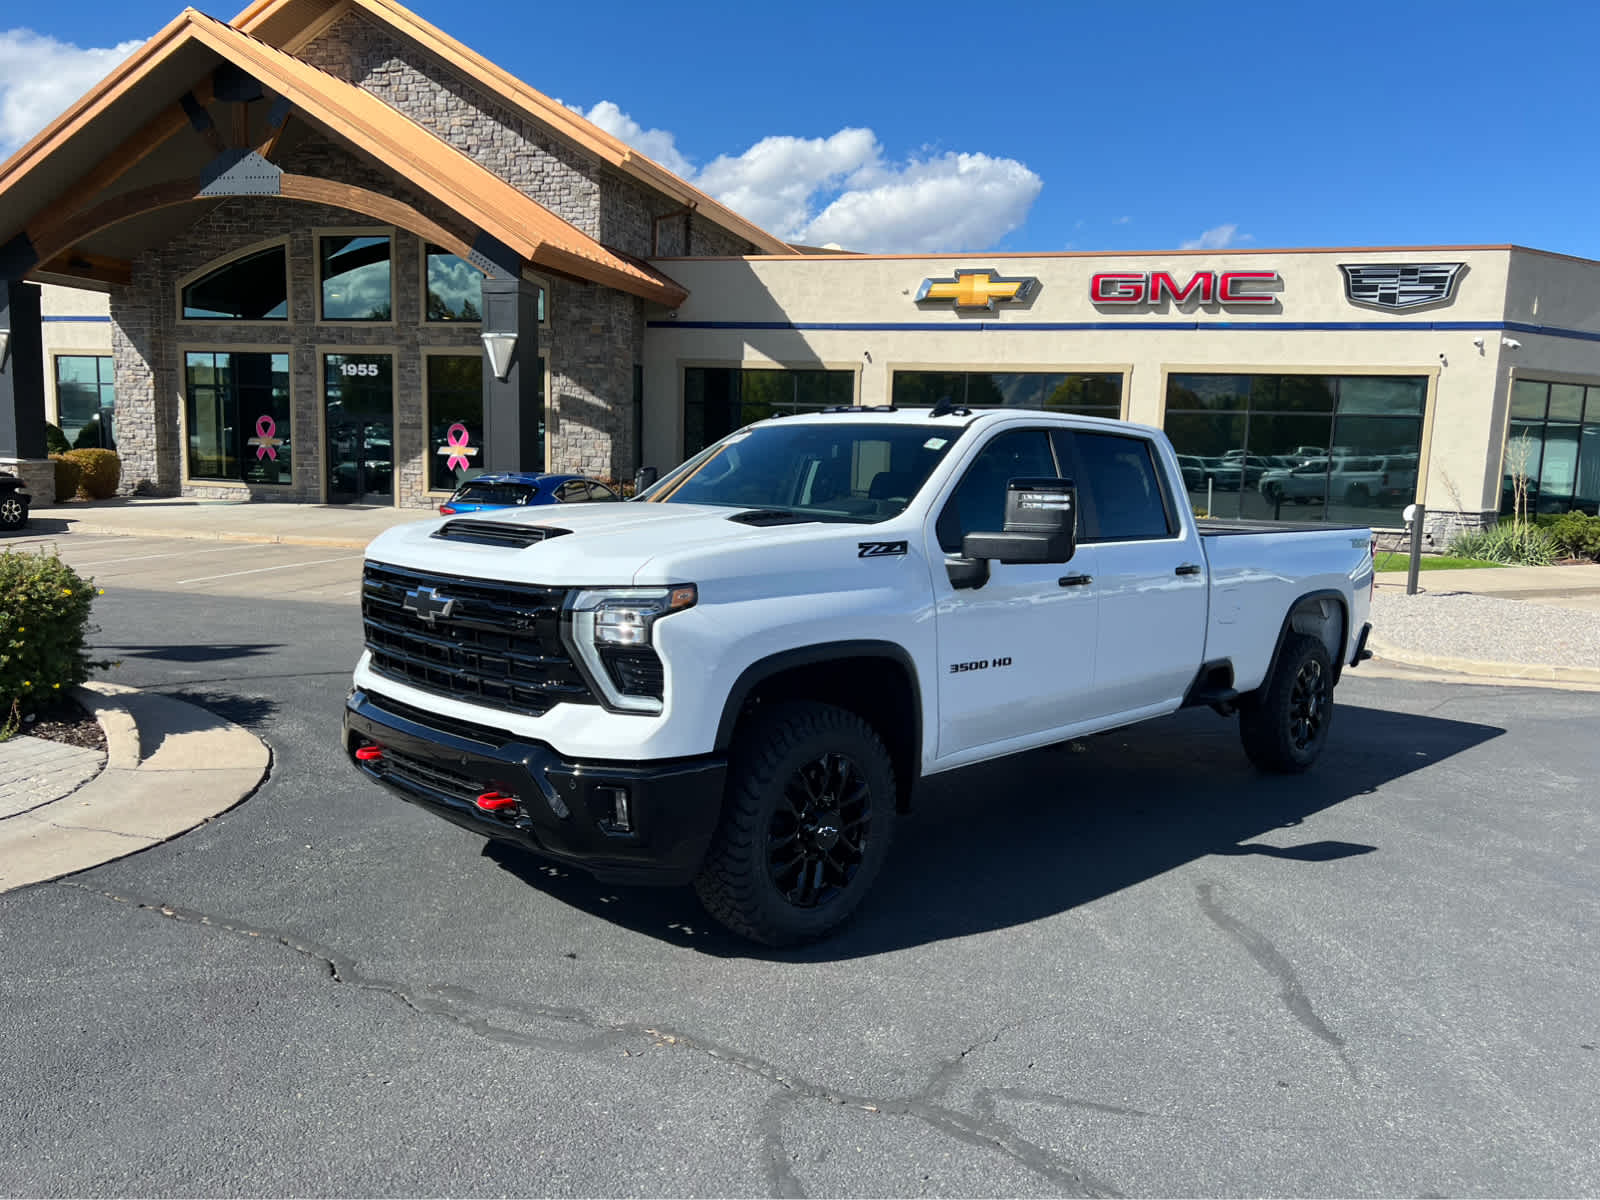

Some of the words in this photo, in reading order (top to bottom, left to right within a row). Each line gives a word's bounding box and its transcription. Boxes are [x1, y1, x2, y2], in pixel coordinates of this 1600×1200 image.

[1089, 270, 1279, 305] GMC
[340, 363, 379, 377] 1955
[950, 659, 989, 674] 3500
[992, 656, 1012, 668] HD
